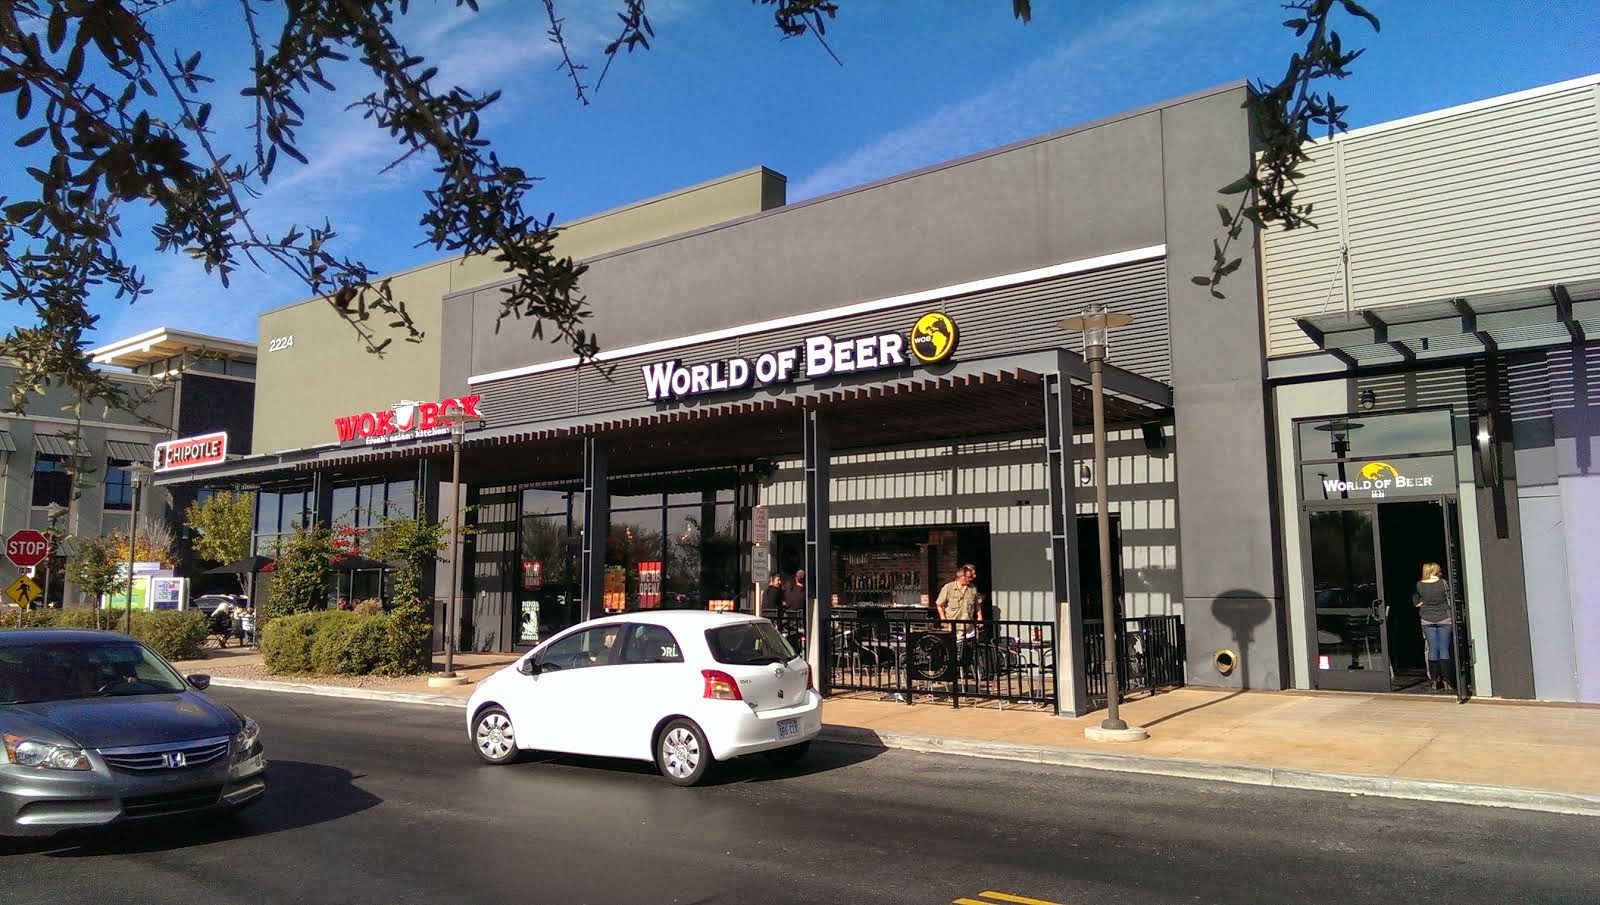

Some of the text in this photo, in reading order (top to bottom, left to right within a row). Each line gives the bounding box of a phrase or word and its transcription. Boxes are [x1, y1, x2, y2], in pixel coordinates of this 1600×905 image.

[269, 335, 293, 352] 2224
[915, 335, 931, 343] WOB
[642, 333, 904, 400] WORLD OF BEER
[334, 409, 397, 442] WOK
[167, 440, 219, 463] CHIPOTLE
[1323, 475, 1433, 492] WORLD OF BEER
[8, 541, 46, 555] STOP
